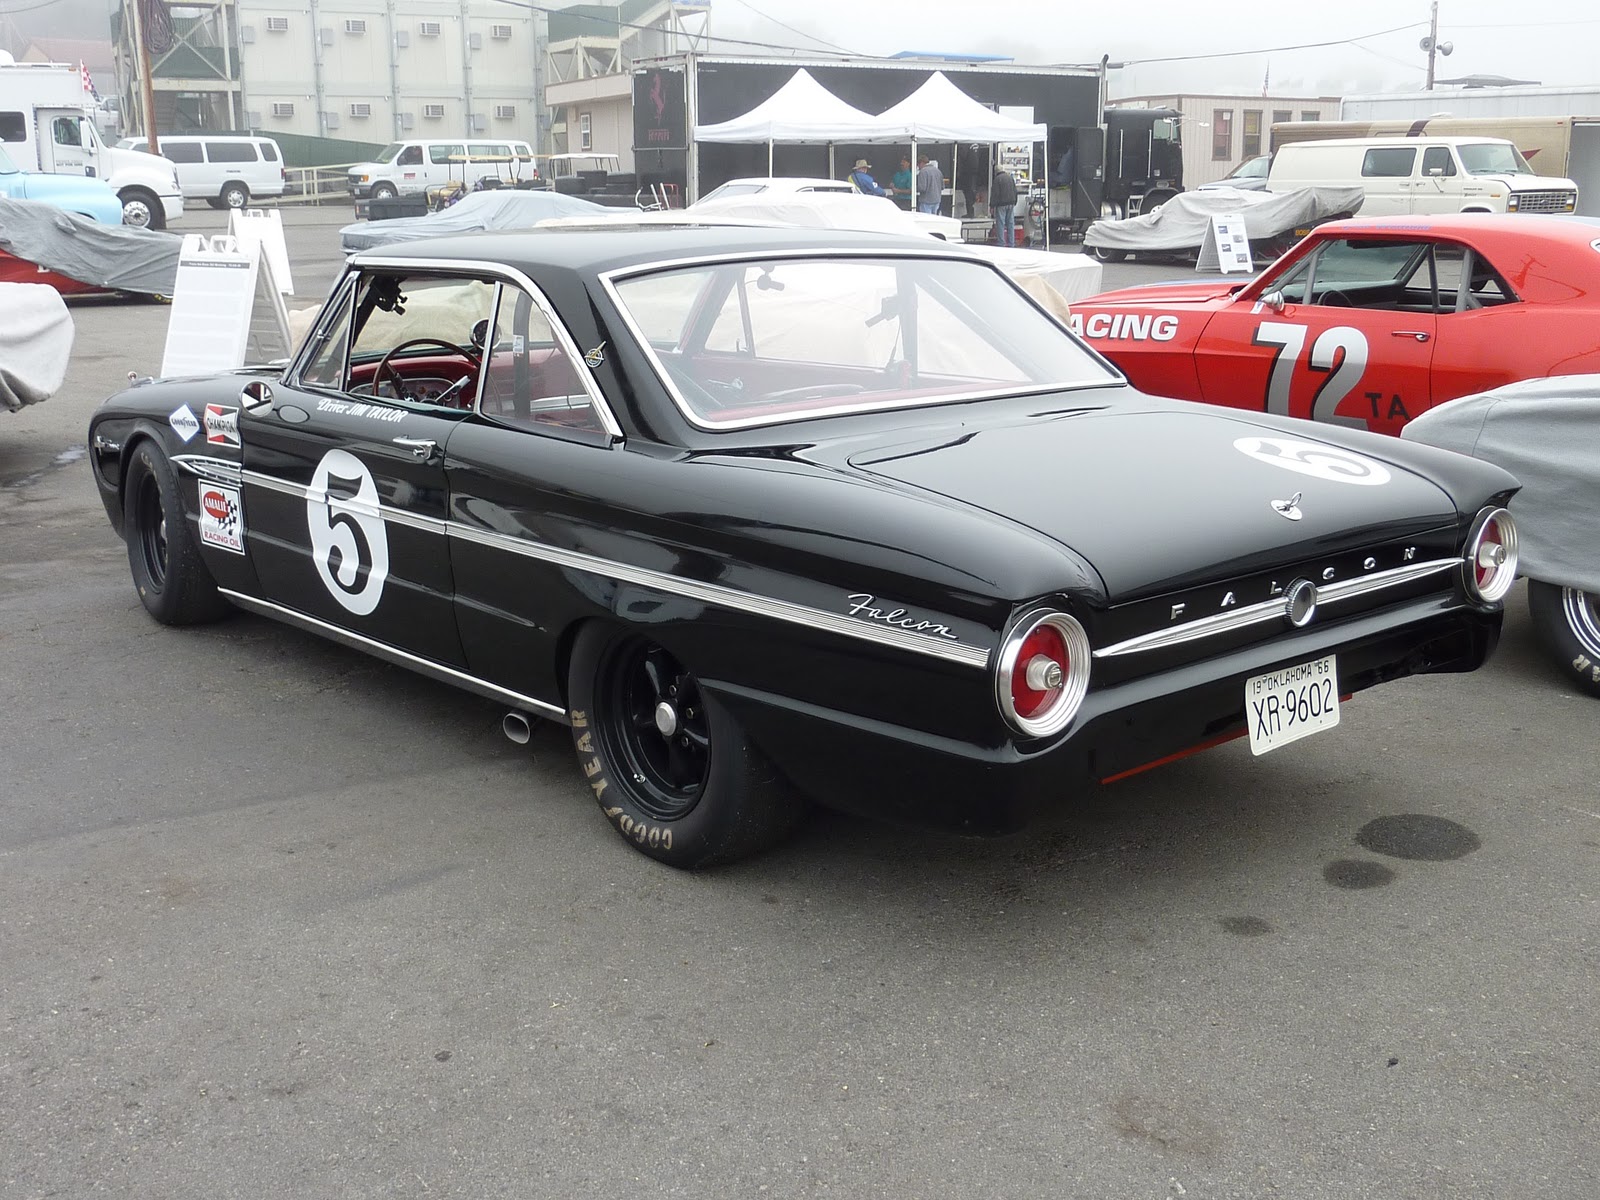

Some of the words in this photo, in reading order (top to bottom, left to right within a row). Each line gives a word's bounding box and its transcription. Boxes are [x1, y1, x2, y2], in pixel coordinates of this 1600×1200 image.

[1254, 320, 1369, 431] 72
[206, 417, 236, 433] CHAMPION
[316, 398, 349, 415] Driver
[345, 402, 371, 417] JIM
[366, 405, 409, 423] TAYLOR
[1255, 439, 1372, 477] 5
[204, 530, 229, 544] RACING
[229, 538, 241, 548] OIL
[327, 470, 374, 597] 5
[1170, 546, 1417, 620] FALCON
[847, 593, 958, 640] Falcon
[1267, 663, 1313, 691] OKLAHOMA
